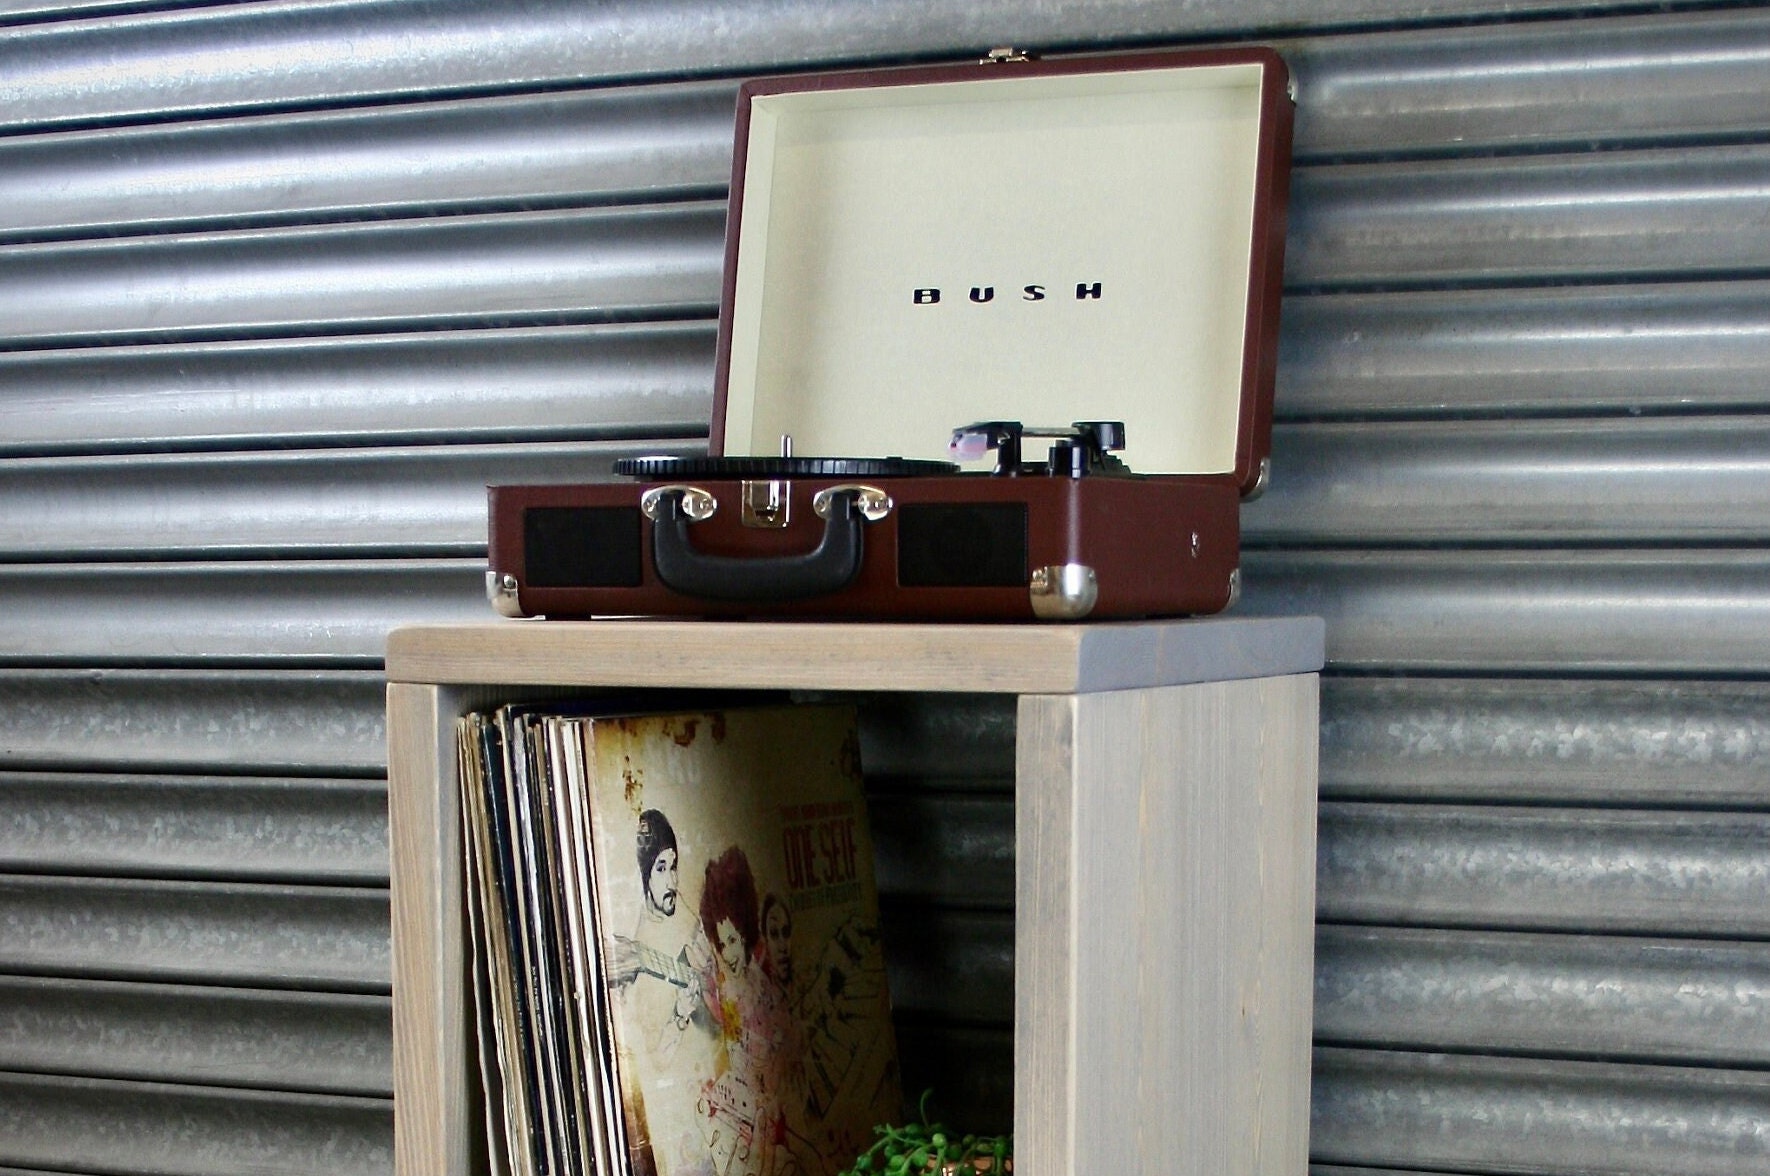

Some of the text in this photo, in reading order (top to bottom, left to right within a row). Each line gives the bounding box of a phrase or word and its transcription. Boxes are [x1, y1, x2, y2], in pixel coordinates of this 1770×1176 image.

[913, 282, 1102, 304] BUSH
[783, 818, 857, 889] ONE SELF
